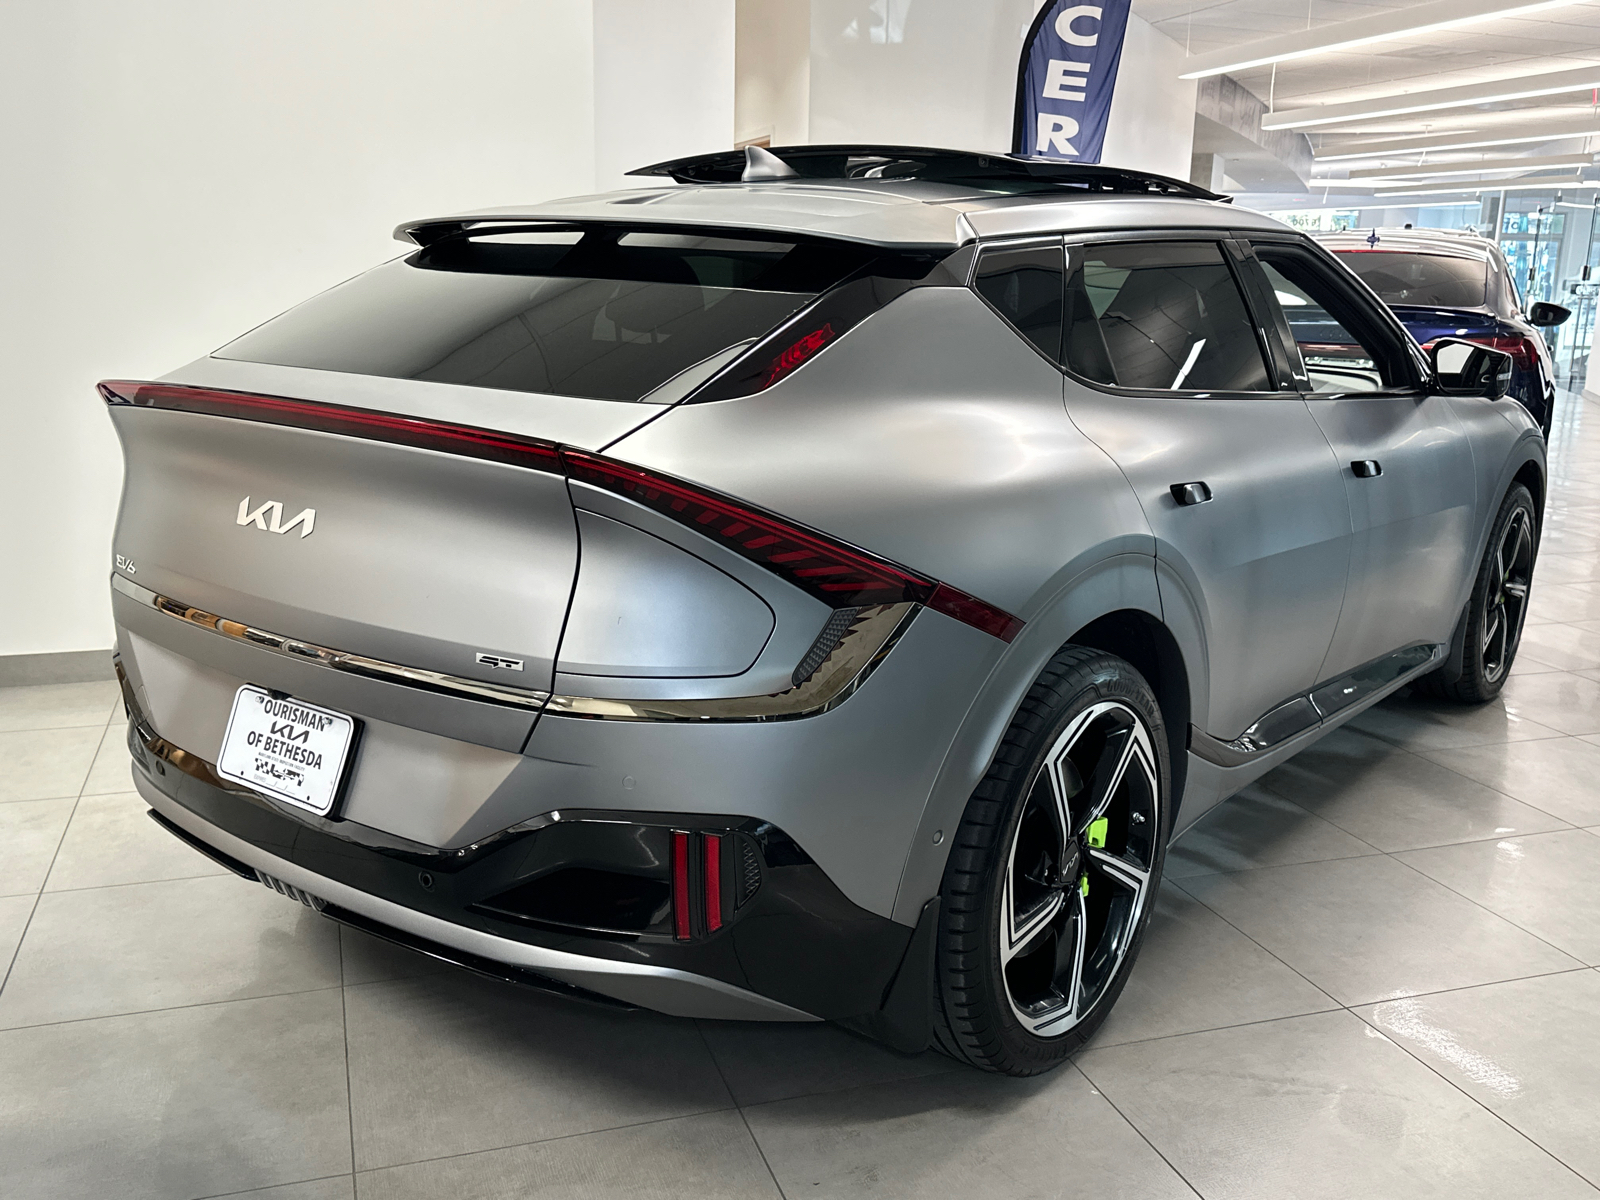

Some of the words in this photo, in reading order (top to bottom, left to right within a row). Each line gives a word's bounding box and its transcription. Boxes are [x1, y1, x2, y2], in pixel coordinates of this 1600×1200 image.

[236, 495, 316, 539] KIA
[116, 553, 136, 574] EV6
[475, 652, 524, 671] GT
[264, 699, 325, 732] OURISMAN
[270, 720, 310, 744] KIA
[247, 731, 263, 748] OF
[264, 736, 322, 770] BETHESDA
